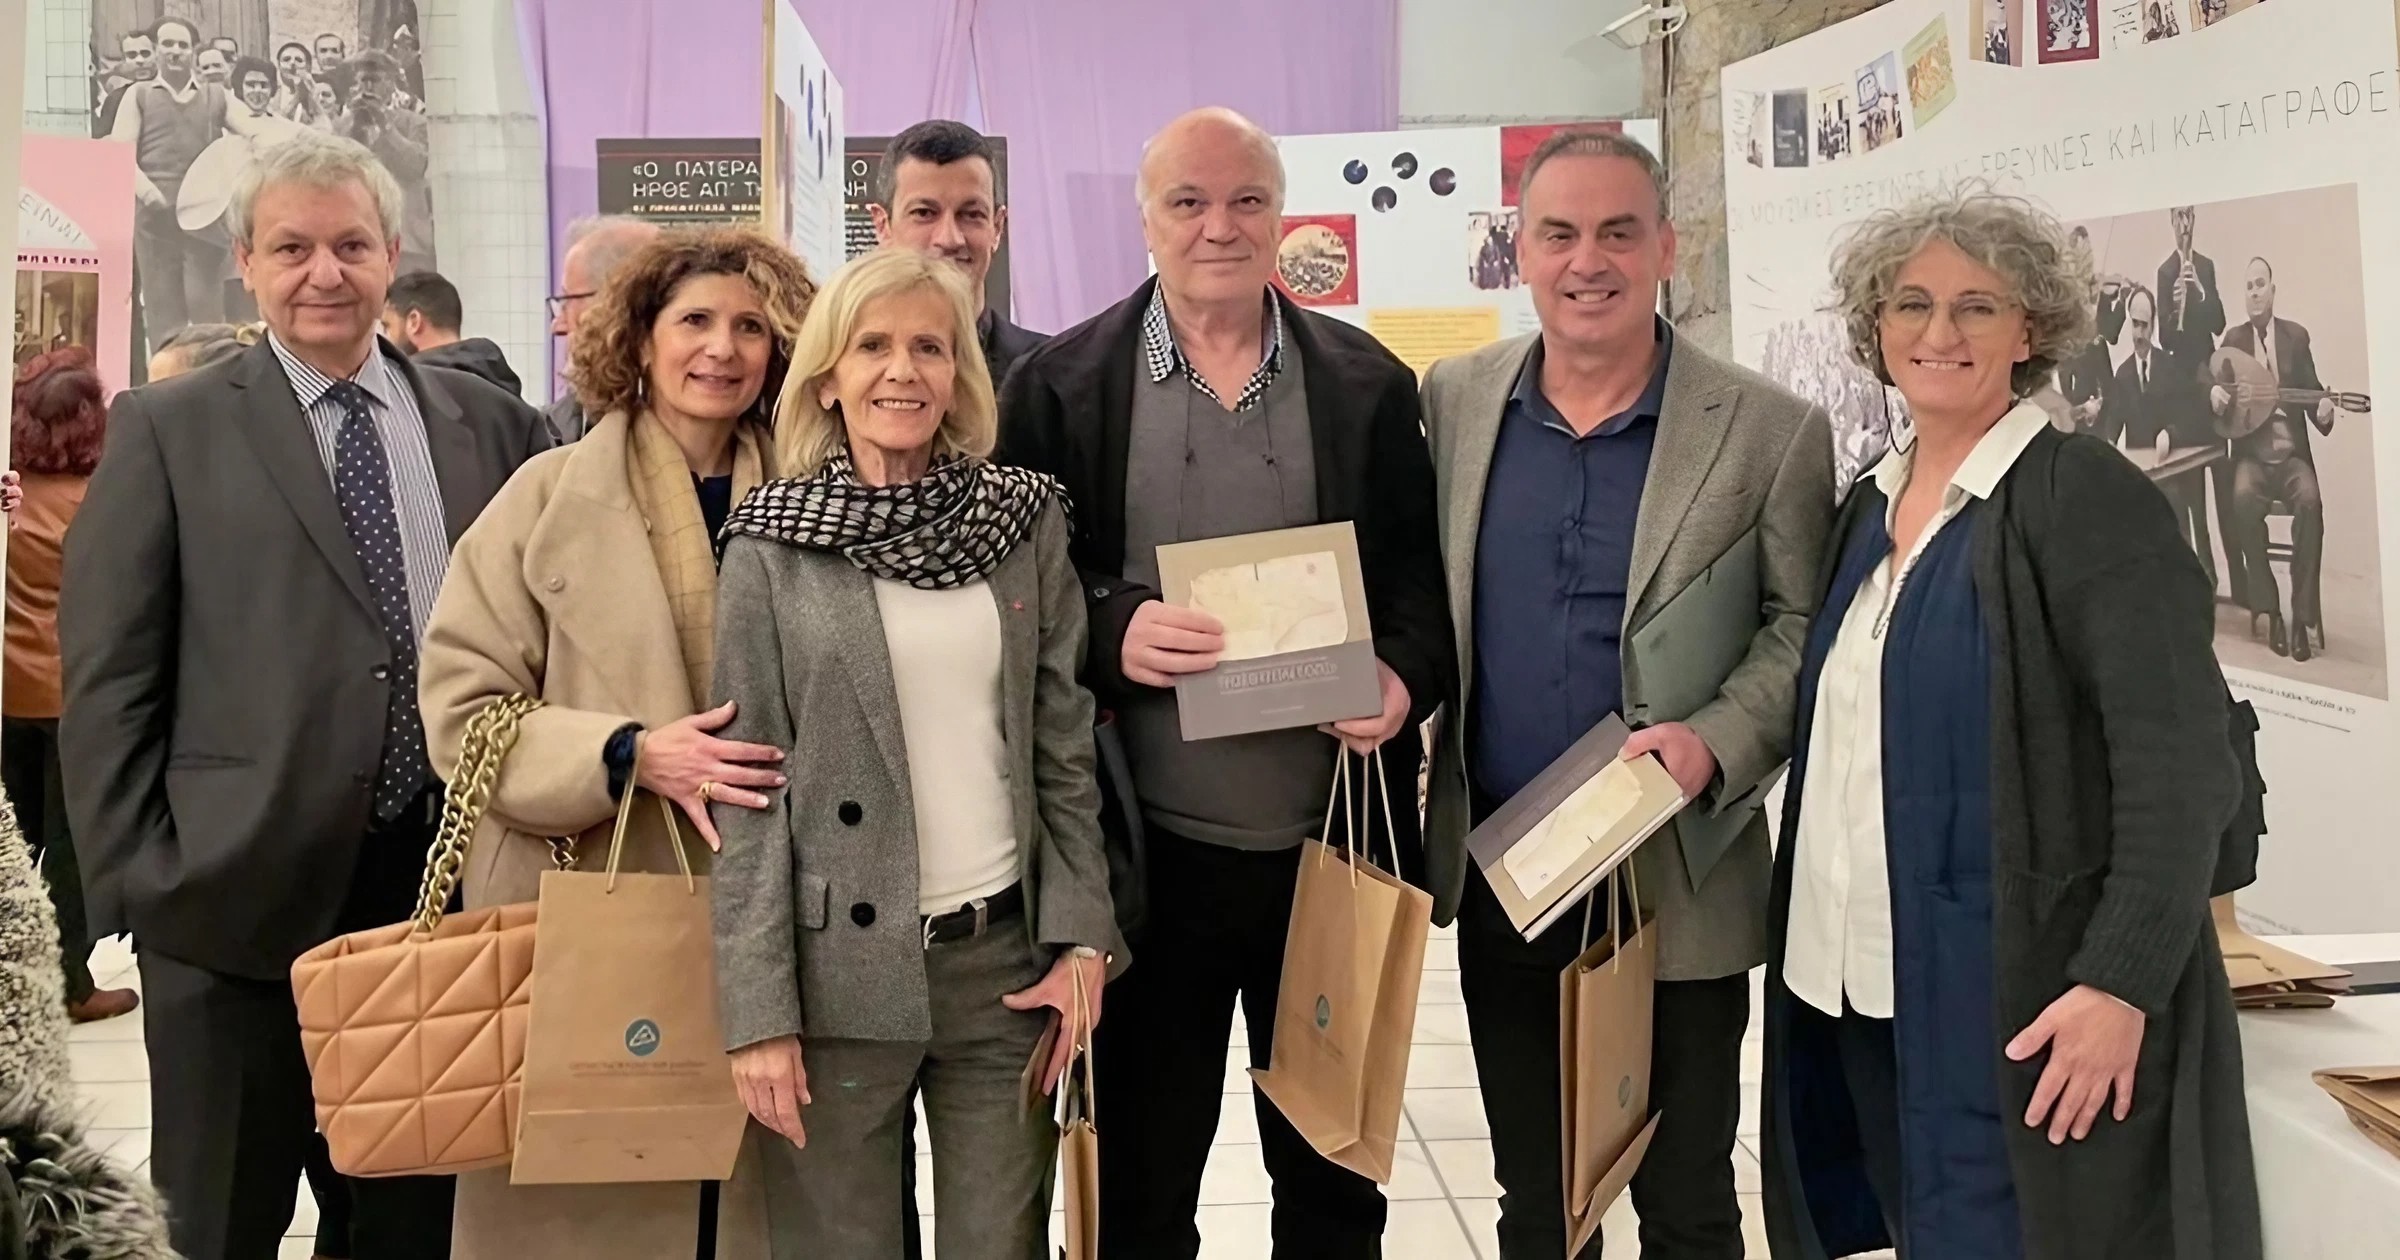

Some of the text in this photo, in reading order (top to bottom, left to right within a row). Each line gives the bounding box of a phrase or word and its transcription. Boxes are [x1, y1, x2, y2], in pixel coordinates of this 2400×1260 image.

[2108, 119, 2155, 161] ΚΑΙ
[2173, 70, 2398, 149] ΚΑΤΑΓΡΑΦΕ
[675, 160, 760, 178] ΠΑΤΕΡΑ
[632, 181, 691, 198] ΗΡΘΕ
